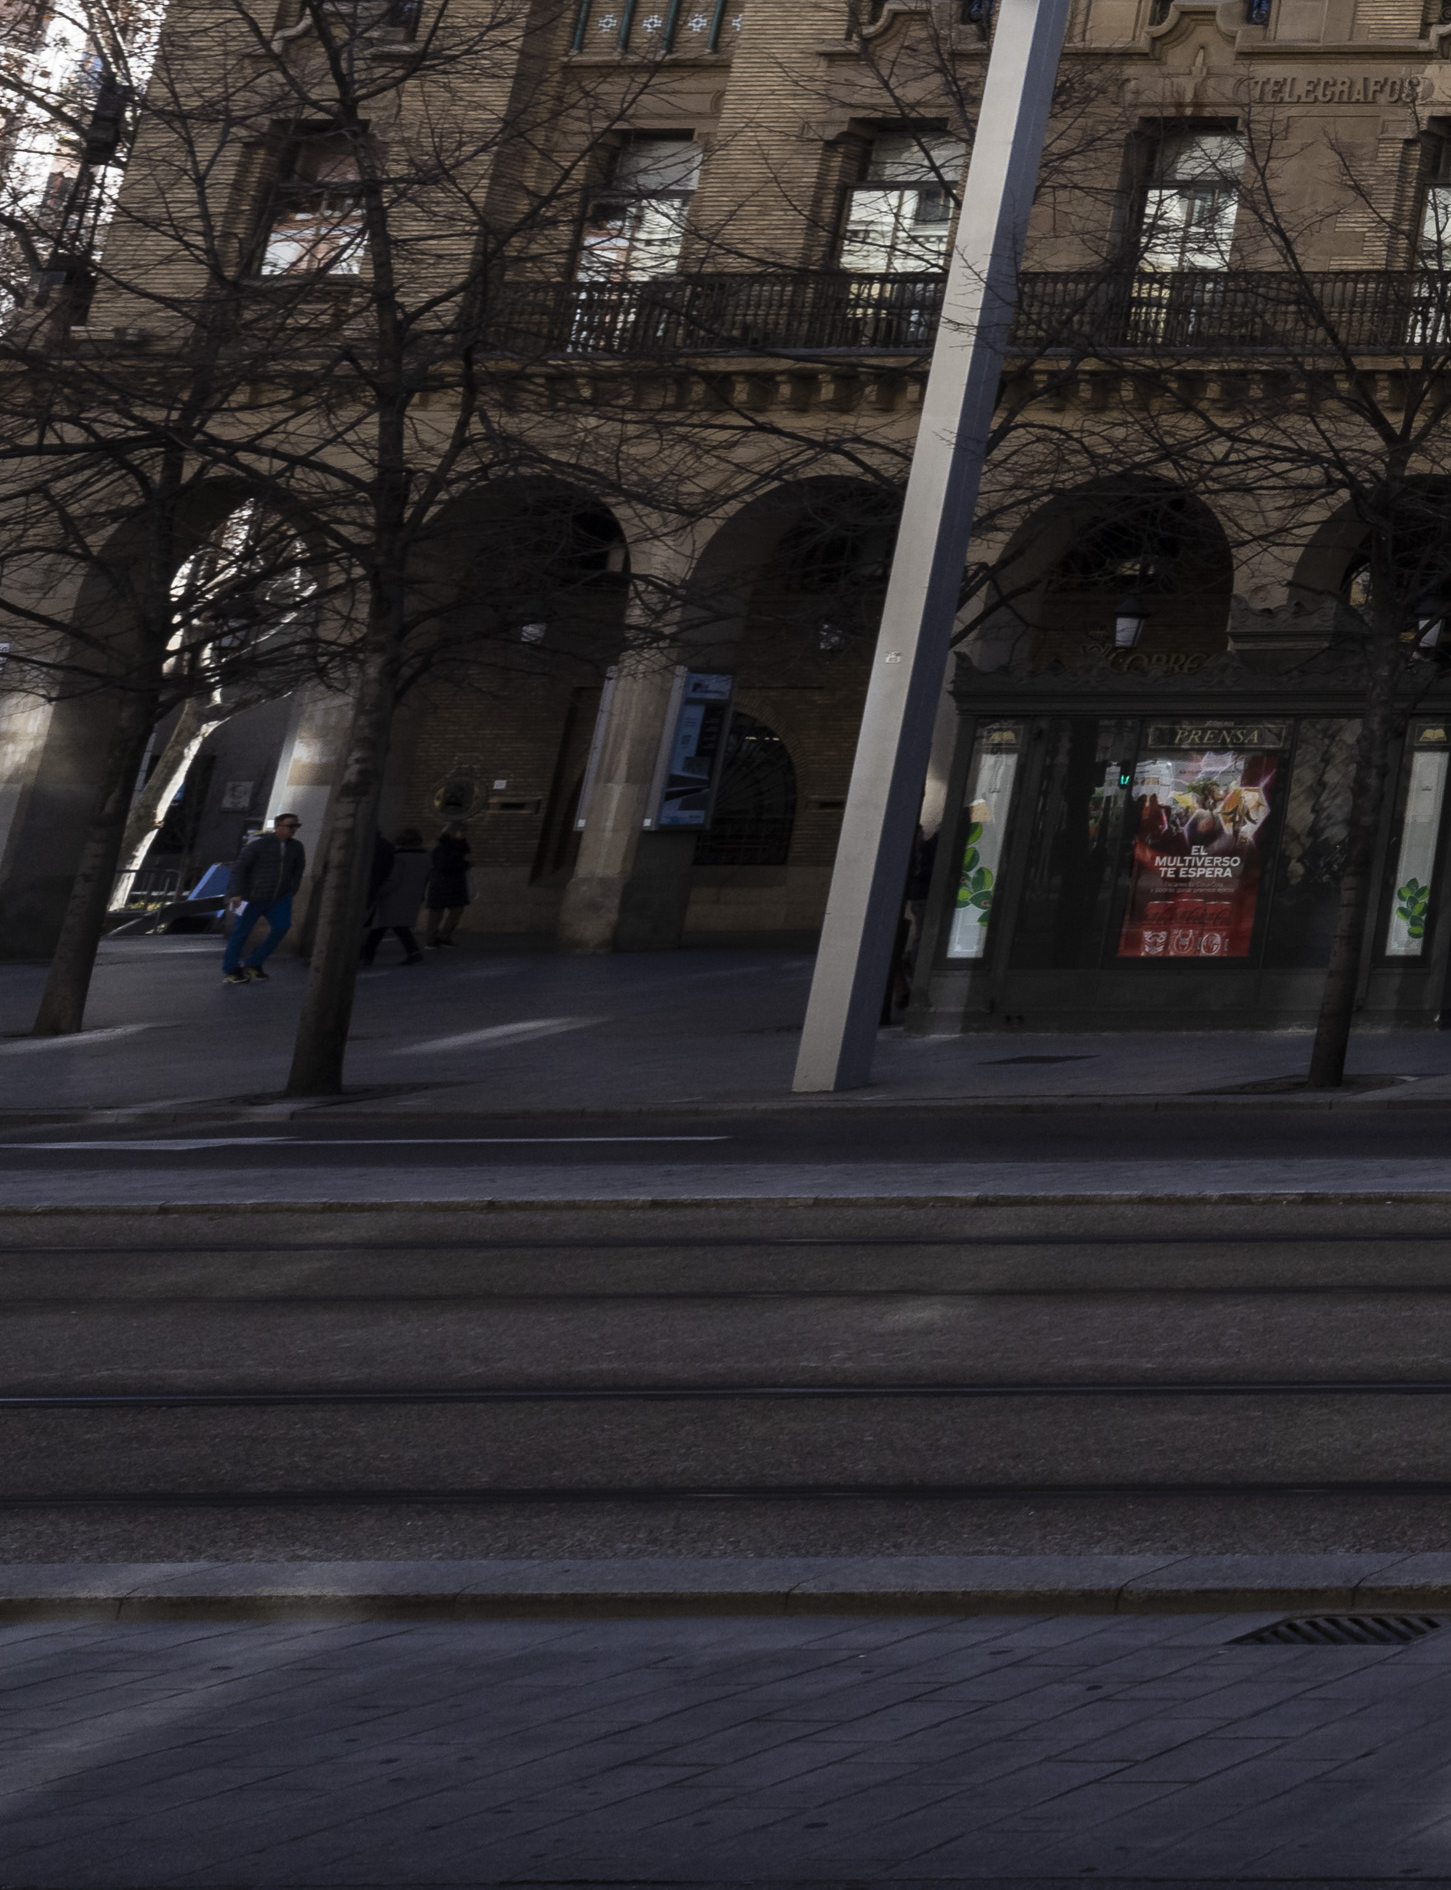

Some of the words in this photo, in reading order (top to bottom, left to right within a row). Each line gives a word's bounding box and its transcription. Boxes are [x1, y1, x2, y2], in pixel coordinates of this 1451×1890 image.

[1252, 76, 1420, 104] TELEGRAFOS
[1107, 648, 1215, 673] CORRE
[1174, 729, 1259, 744] PRENSA
[1191, 845, 1208, 856] EL
[1154, 856, 1241, 867] MULTIVERSO
[1160, 867, 1176, 878] TE
[1179, 867, 1233, 878] ESPERA
